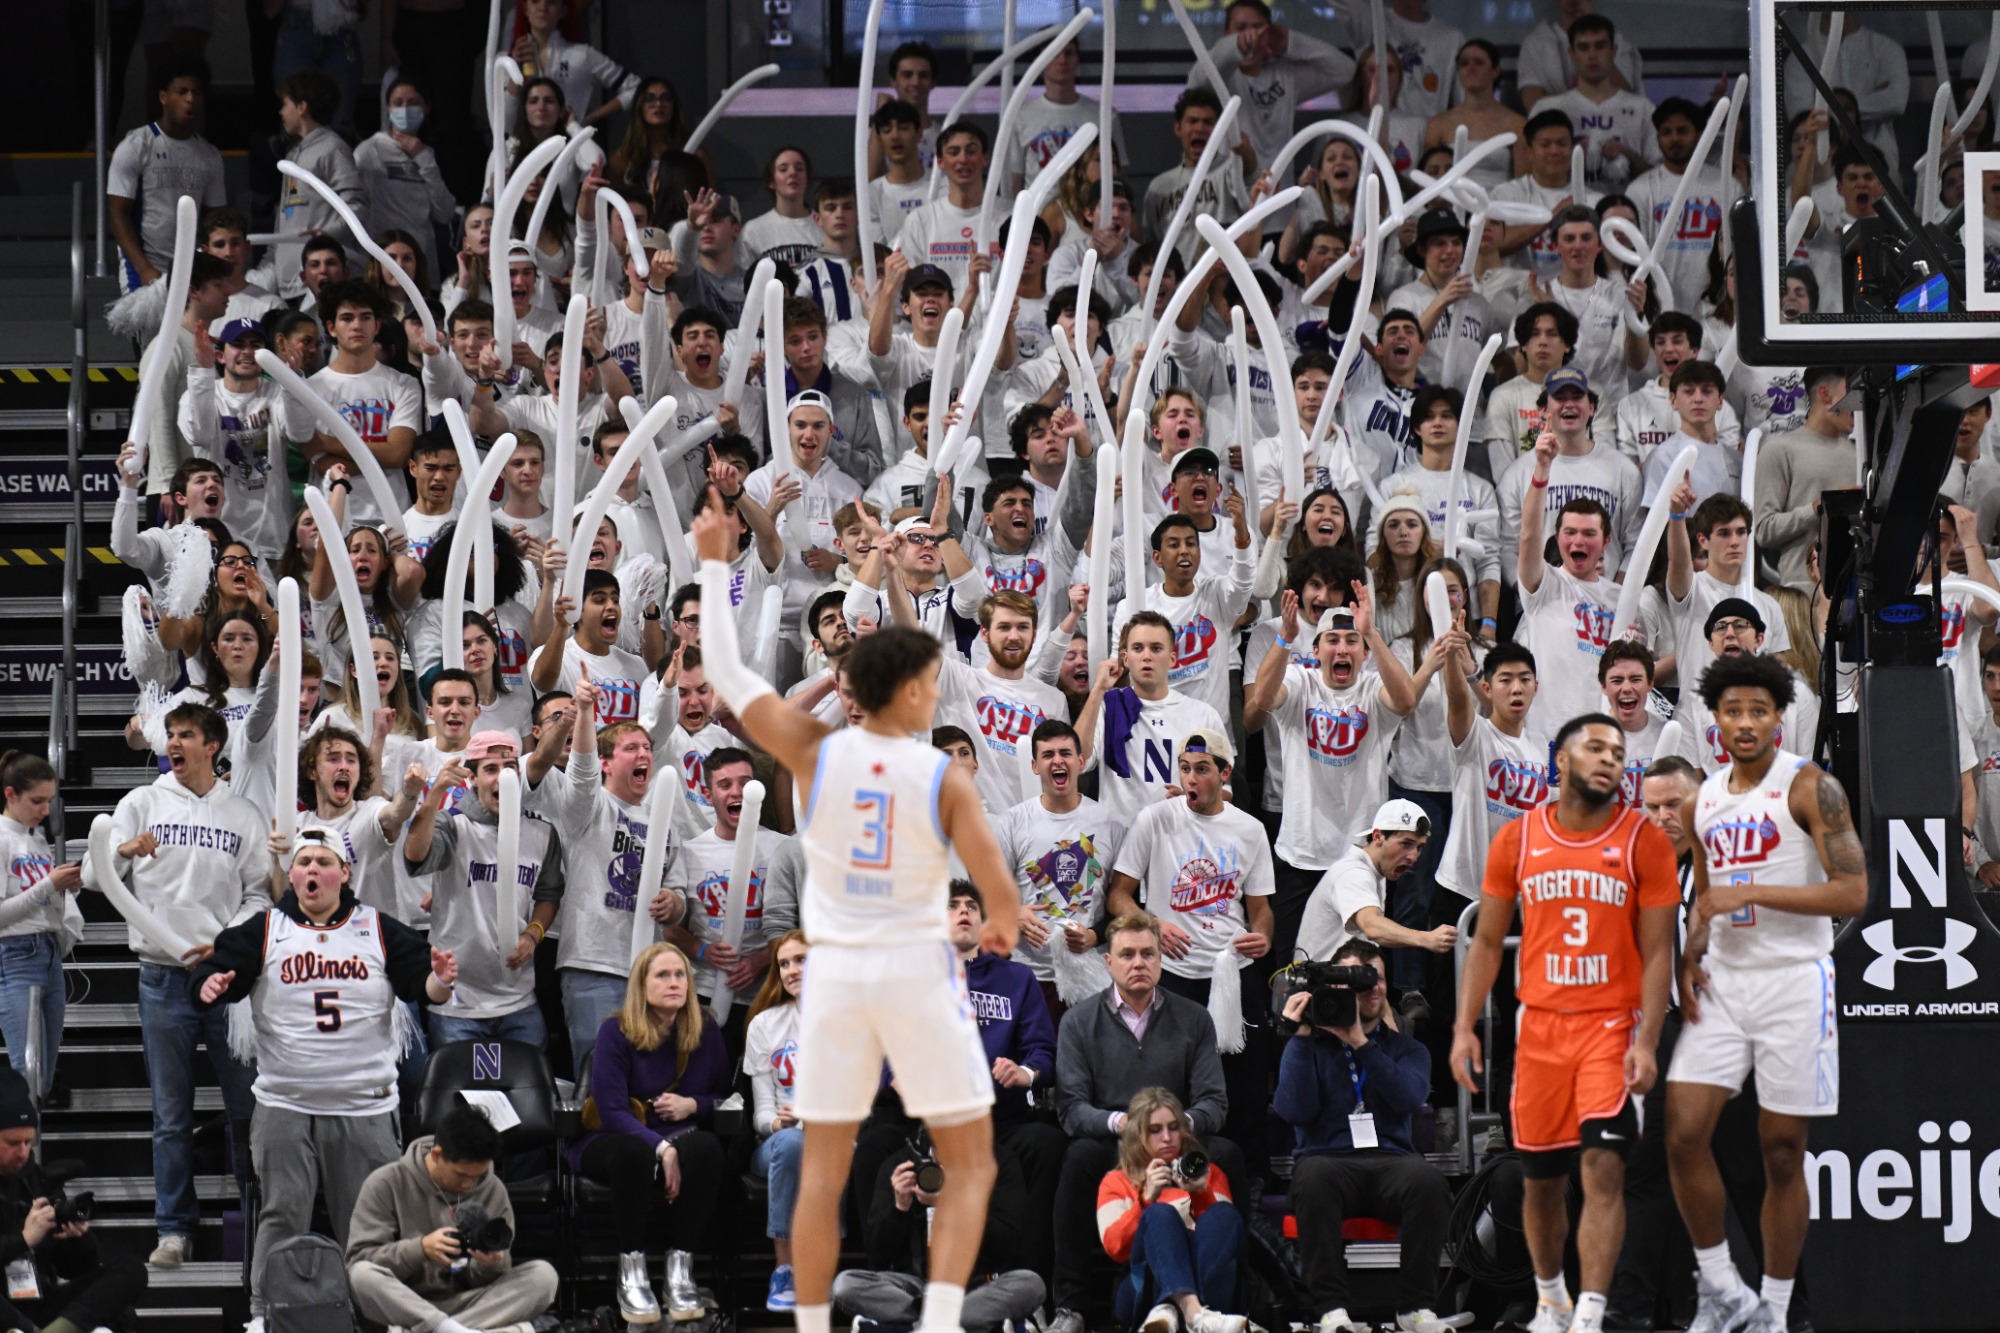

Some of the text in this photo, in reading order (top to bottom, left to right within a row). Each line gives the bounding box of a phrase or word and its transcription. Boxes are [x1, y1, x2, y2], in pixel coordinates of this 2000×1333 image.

[1581, 115, 1614, 131] NU
[644, 228, 653, 239] N
[241, 317, 252, 328] N
[37, 474, 109, 492] WACH
[25, 663, 101, 681] WACH
[977, 696, 1049, 745] NU
[1305, 701, 1368, 757] NU
[1145, 739, 1172, 784] N
[1309, 748, 1358, 767] NORTHWESTERN
[1487, 756, 1549, 812] NU
[148, 824, 243, 859] NORTHWESTERN
[851, 789, 894, 871] 3
[1704, 811, 1782, 868] NU
[467, 859, 540, 889] NORTHTERN
[613, 857, 625, 877] N
[1056, 875, 1077, 883] BELL
[1889, 818, 1947, 908] N
[1171, 872, 1240, 908] WILDCATS
[1522, 868, 1629, 907] FIGHTING
[1562, 906, 1589, 947] 3
[280, 951, 369, 984] Illinois
[1545, 953, 1609, 985] ILLINI
[314, 990, 342, 1033] 5
[1843, 1001, 1999, 1017] UNDER ARMOUR
[473, 1042, 501, 1081] N
